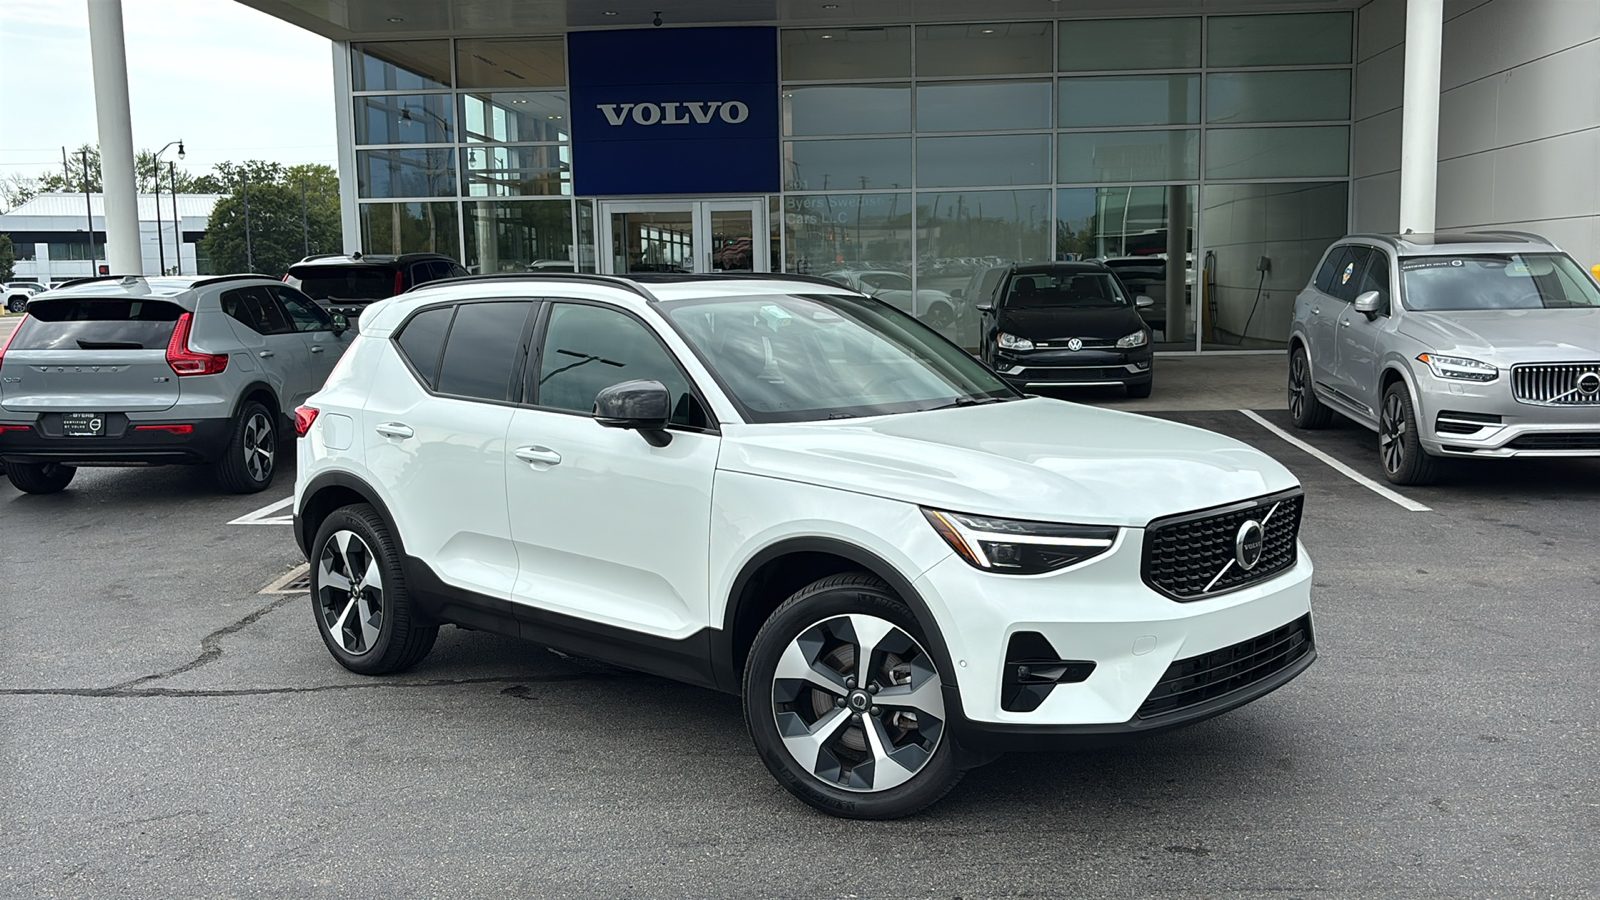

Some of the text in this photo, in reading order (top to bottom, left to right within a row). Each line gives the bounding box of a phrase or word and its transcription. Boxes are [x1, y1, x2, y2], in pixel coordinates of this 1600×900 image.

[597, 101, 749, 126] VOLVO
[787, 195, 883, 211] Byers Swedish
[786, 212, 848, 224] Cars LLC
